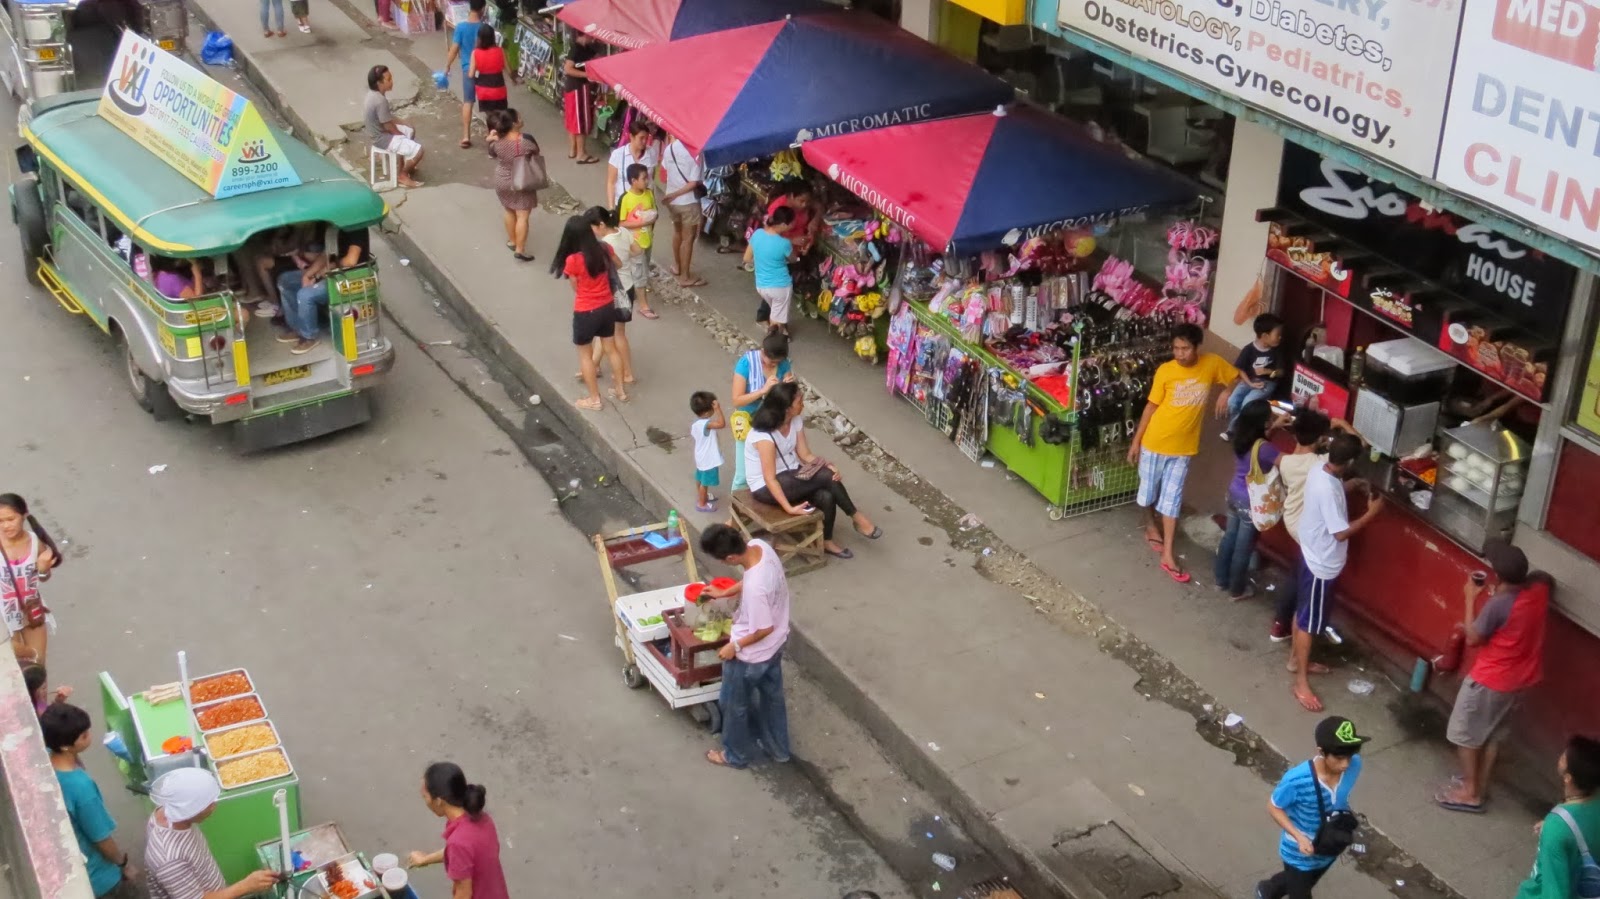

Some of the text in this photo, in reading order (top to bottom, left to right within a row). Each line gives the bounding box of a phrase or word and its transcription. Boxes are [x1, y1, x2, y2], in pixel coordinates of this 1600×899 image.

[1250, 0, 1392, 71] Diabetes,
[1084, 1, 1396, 148] Obstetrics-Gynecology,
[1246, 30, 1412, 117] Pediatrics,
[153, 80, 235, 147] OPPORTUNITIES
[816, 103, 931, 137] MICROMATIC
[223, 177, 289, 191] careersph@vxi.com
[232, 162, 278, 177] 899-2200
[840, 171, 915, 231] MICROMATIC
[1466, 253, 1536, 307] HOUSE
